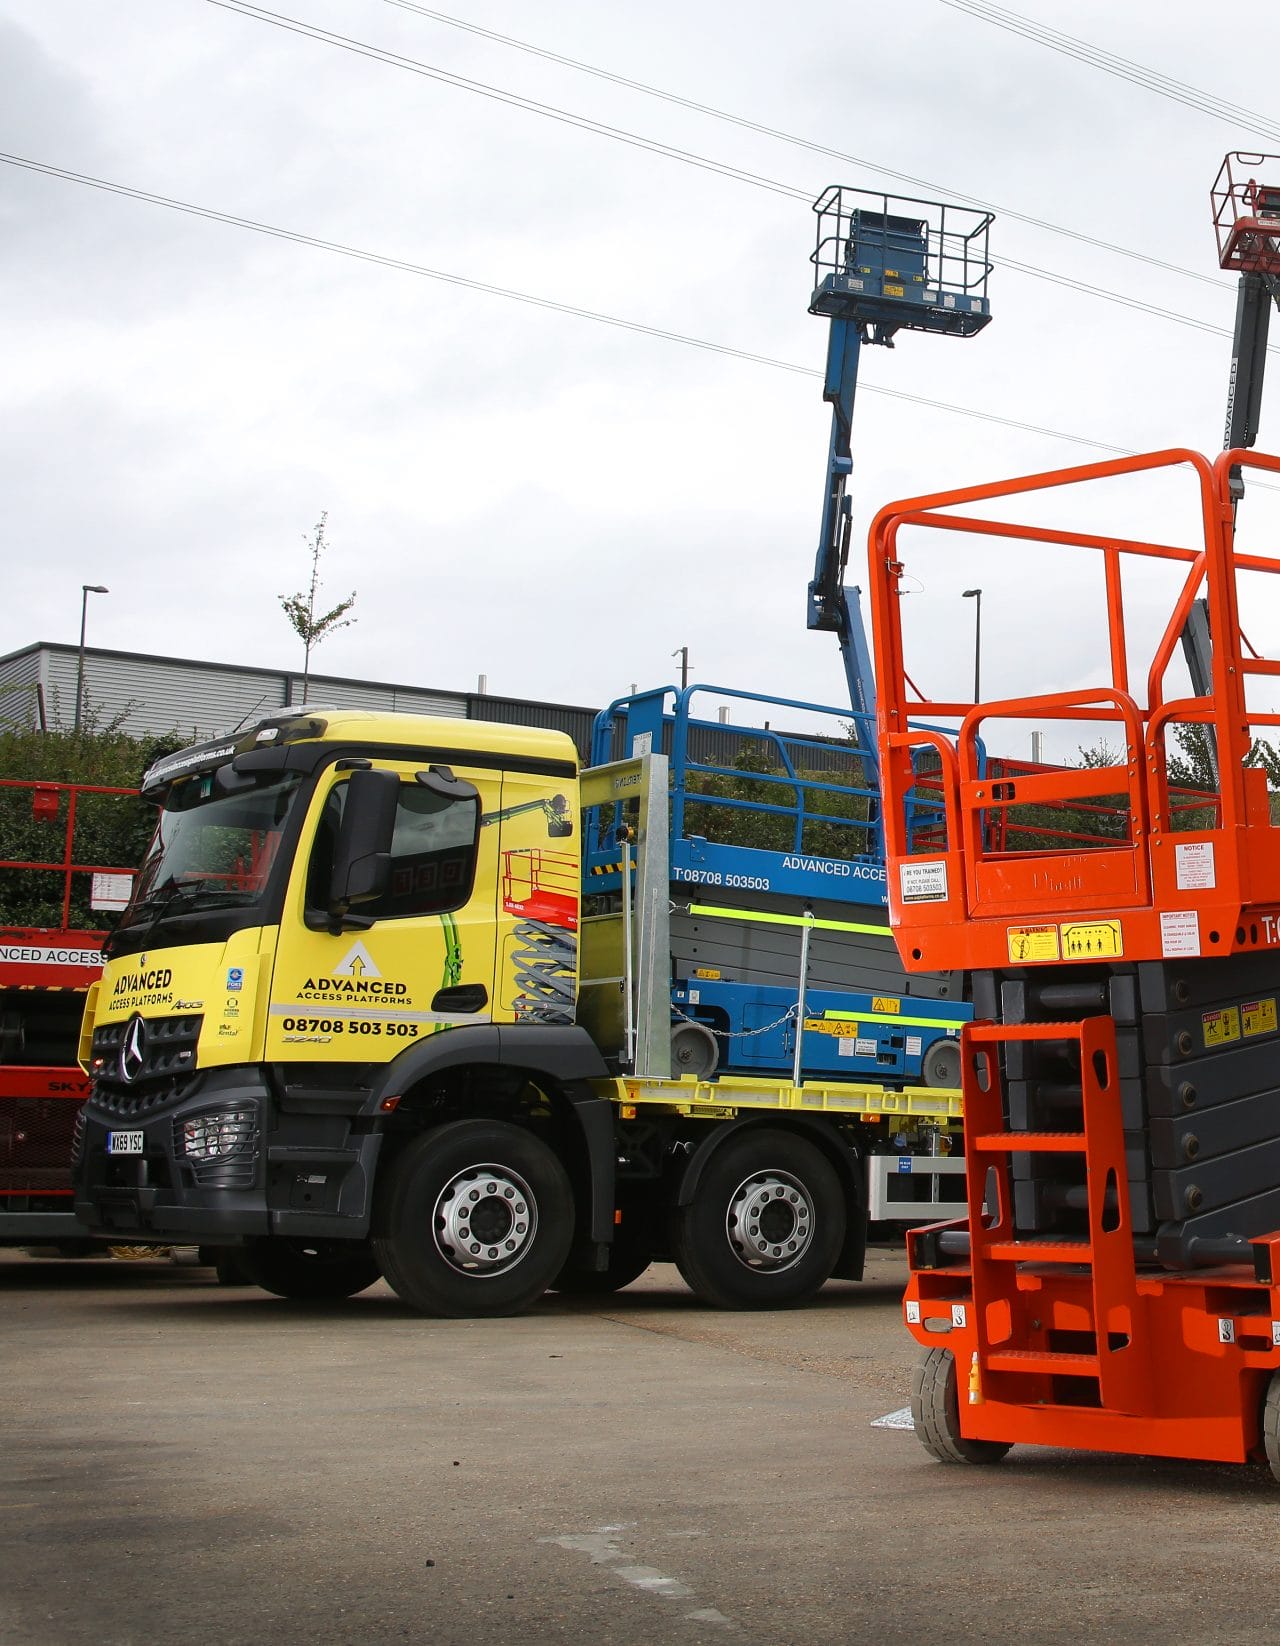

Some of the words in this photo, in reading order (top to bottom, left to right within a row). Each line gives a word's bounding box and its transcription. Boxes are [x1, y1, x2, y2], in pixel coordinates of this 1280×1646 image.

[1224, 363, 1236, 450] ADVANCED
[783, 856, 850, 877] ADVANCED
[725, 876, 770, 891] 503503
[113, 969, 172, 996] ADVANCED
[303, 978, 407, 995] ADVANCED
[109, 998, 130, 1011] ACCESS
[132, 993, 173, 1007] PLATFORMS
[296, 992, 342, 1000] ACCESS
[347, 995, 412, 1005] PLATFORMS
[283, 1018, 344, 1033] 08708
[349, 1022, 381, 1035] 503
[386, 1023, 418, 1037] 503
[112, 1134, 128, 1150] WX69
[129, 1134, 142, 1150] YSC
